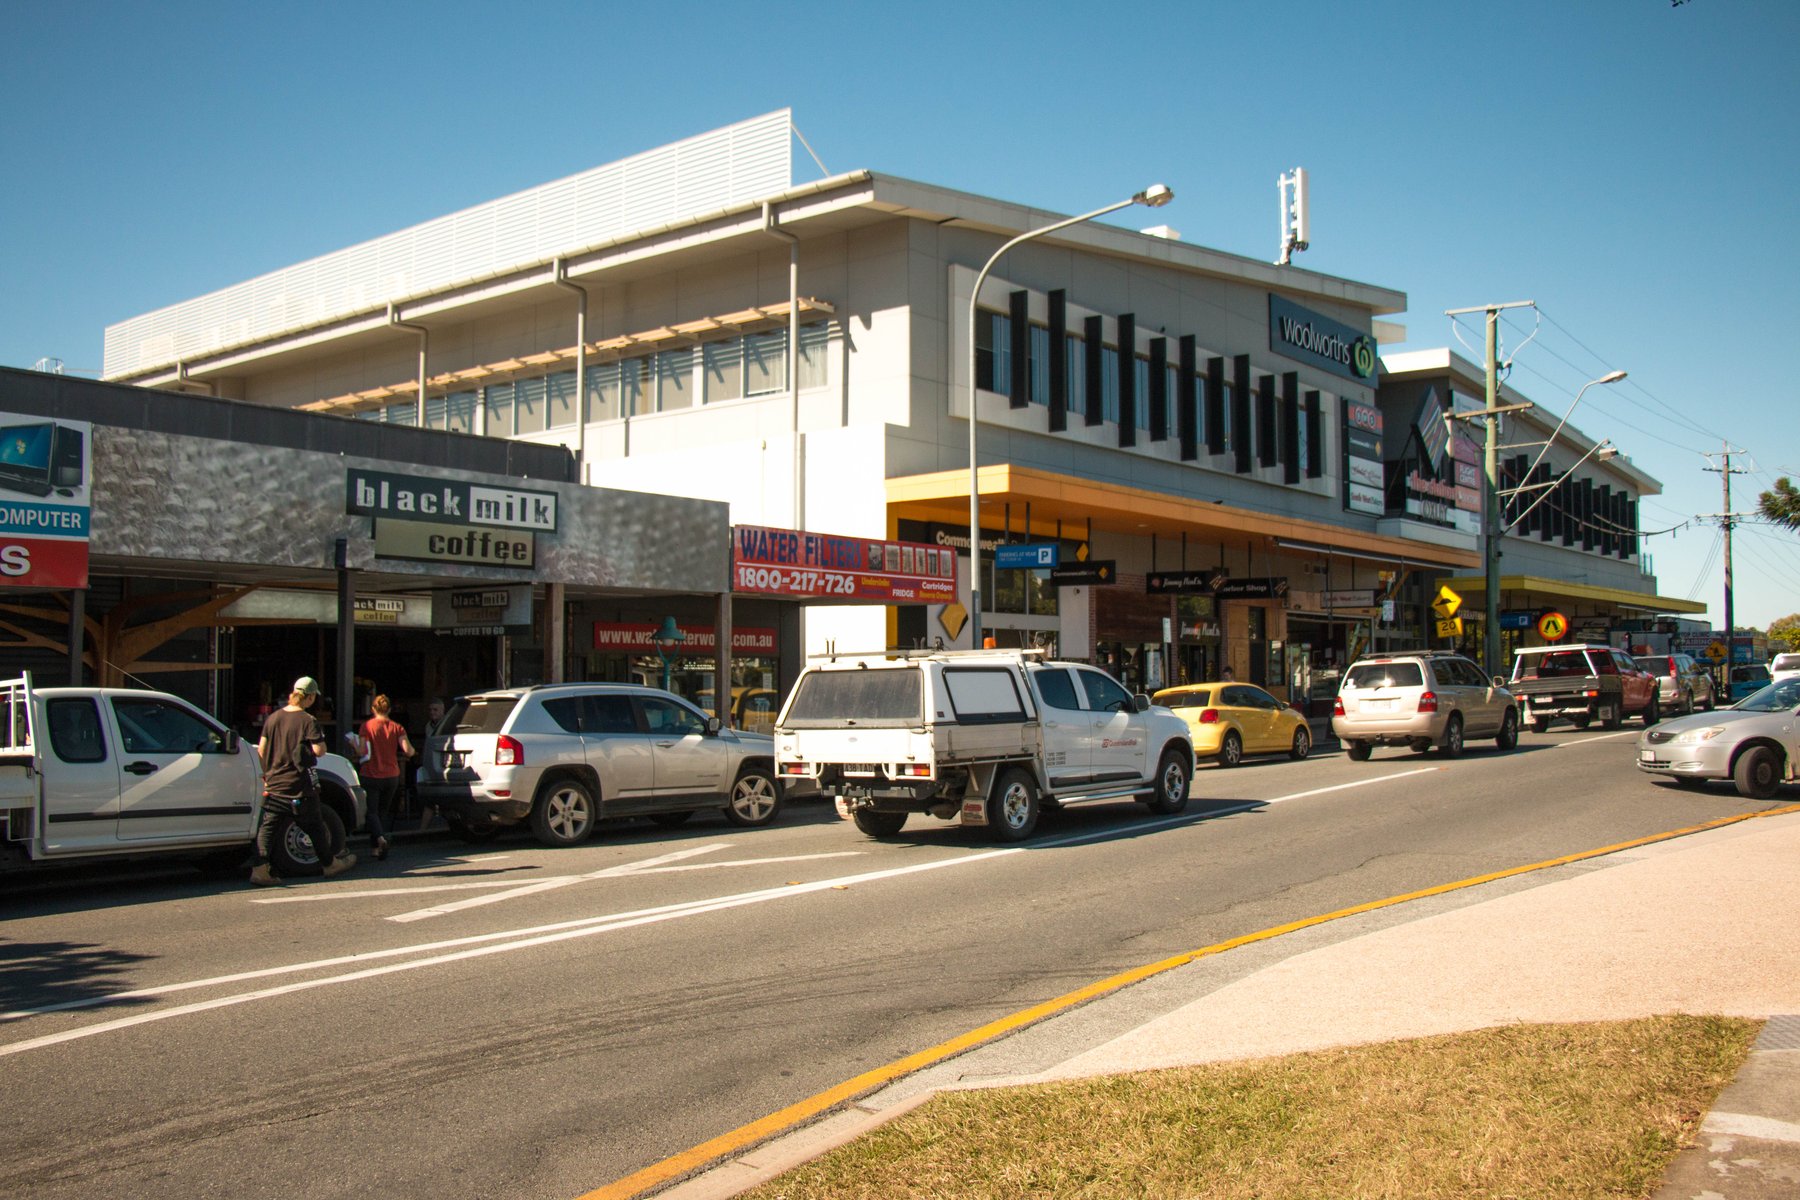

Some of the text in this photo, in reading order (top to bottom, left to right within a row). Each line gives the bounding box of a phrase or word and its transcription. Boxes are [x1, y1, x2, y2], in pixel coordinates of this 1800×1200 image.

[1283, 316, 1351, 366] Woolworths
[356, 478, 549, 524] black milk
[0, 507, 82, 529] OMPUTER
[428, 531, 527, 560] coffee
[741, 529, 862, 569] WATER FILTERS
[1041, 551, 1049, 561] P
[0, 545, 31, 576] S
[739, 567, 855, 594] 1800-217-726
[922, 581, 953, 591] Cartridges
[892, 589, 914, 598] FRIDGE
[354, 601, 374, 609] ack
[453, 626, 505, 636] COFFEE TO GO
[1441, 621, 1456, 631] 20
